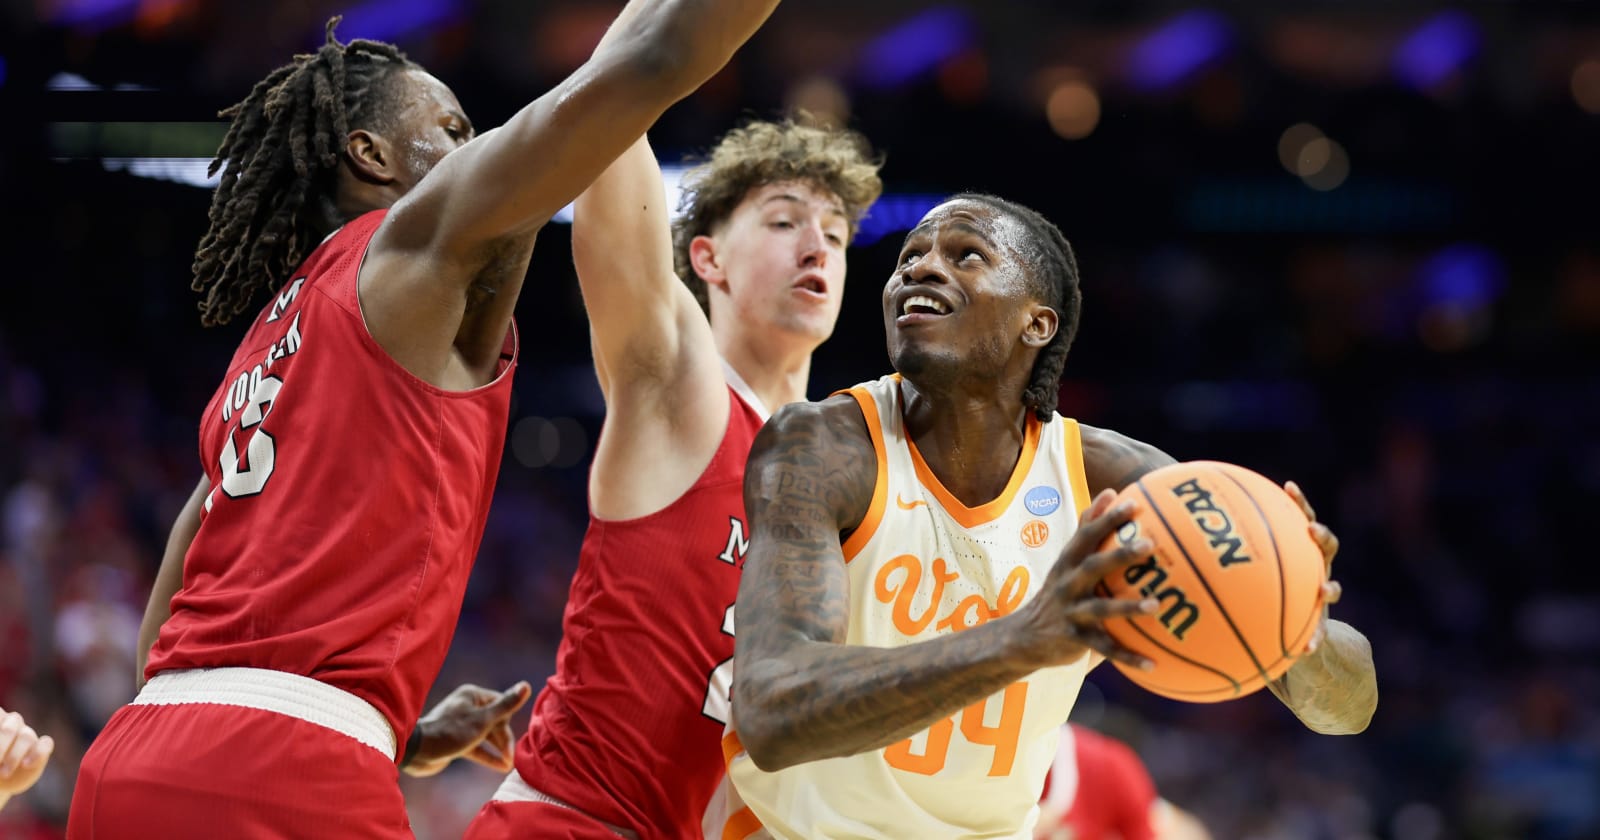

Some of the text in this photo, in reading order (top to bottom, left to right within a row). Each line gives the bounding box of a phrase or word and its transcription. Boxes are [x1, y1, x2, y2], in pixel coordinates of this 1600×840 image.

[1030, 496, 1060, 510] NCAA
[1022, 521, 1047, 546] SEC
[1171, 478, 1252, 568] NCAA
